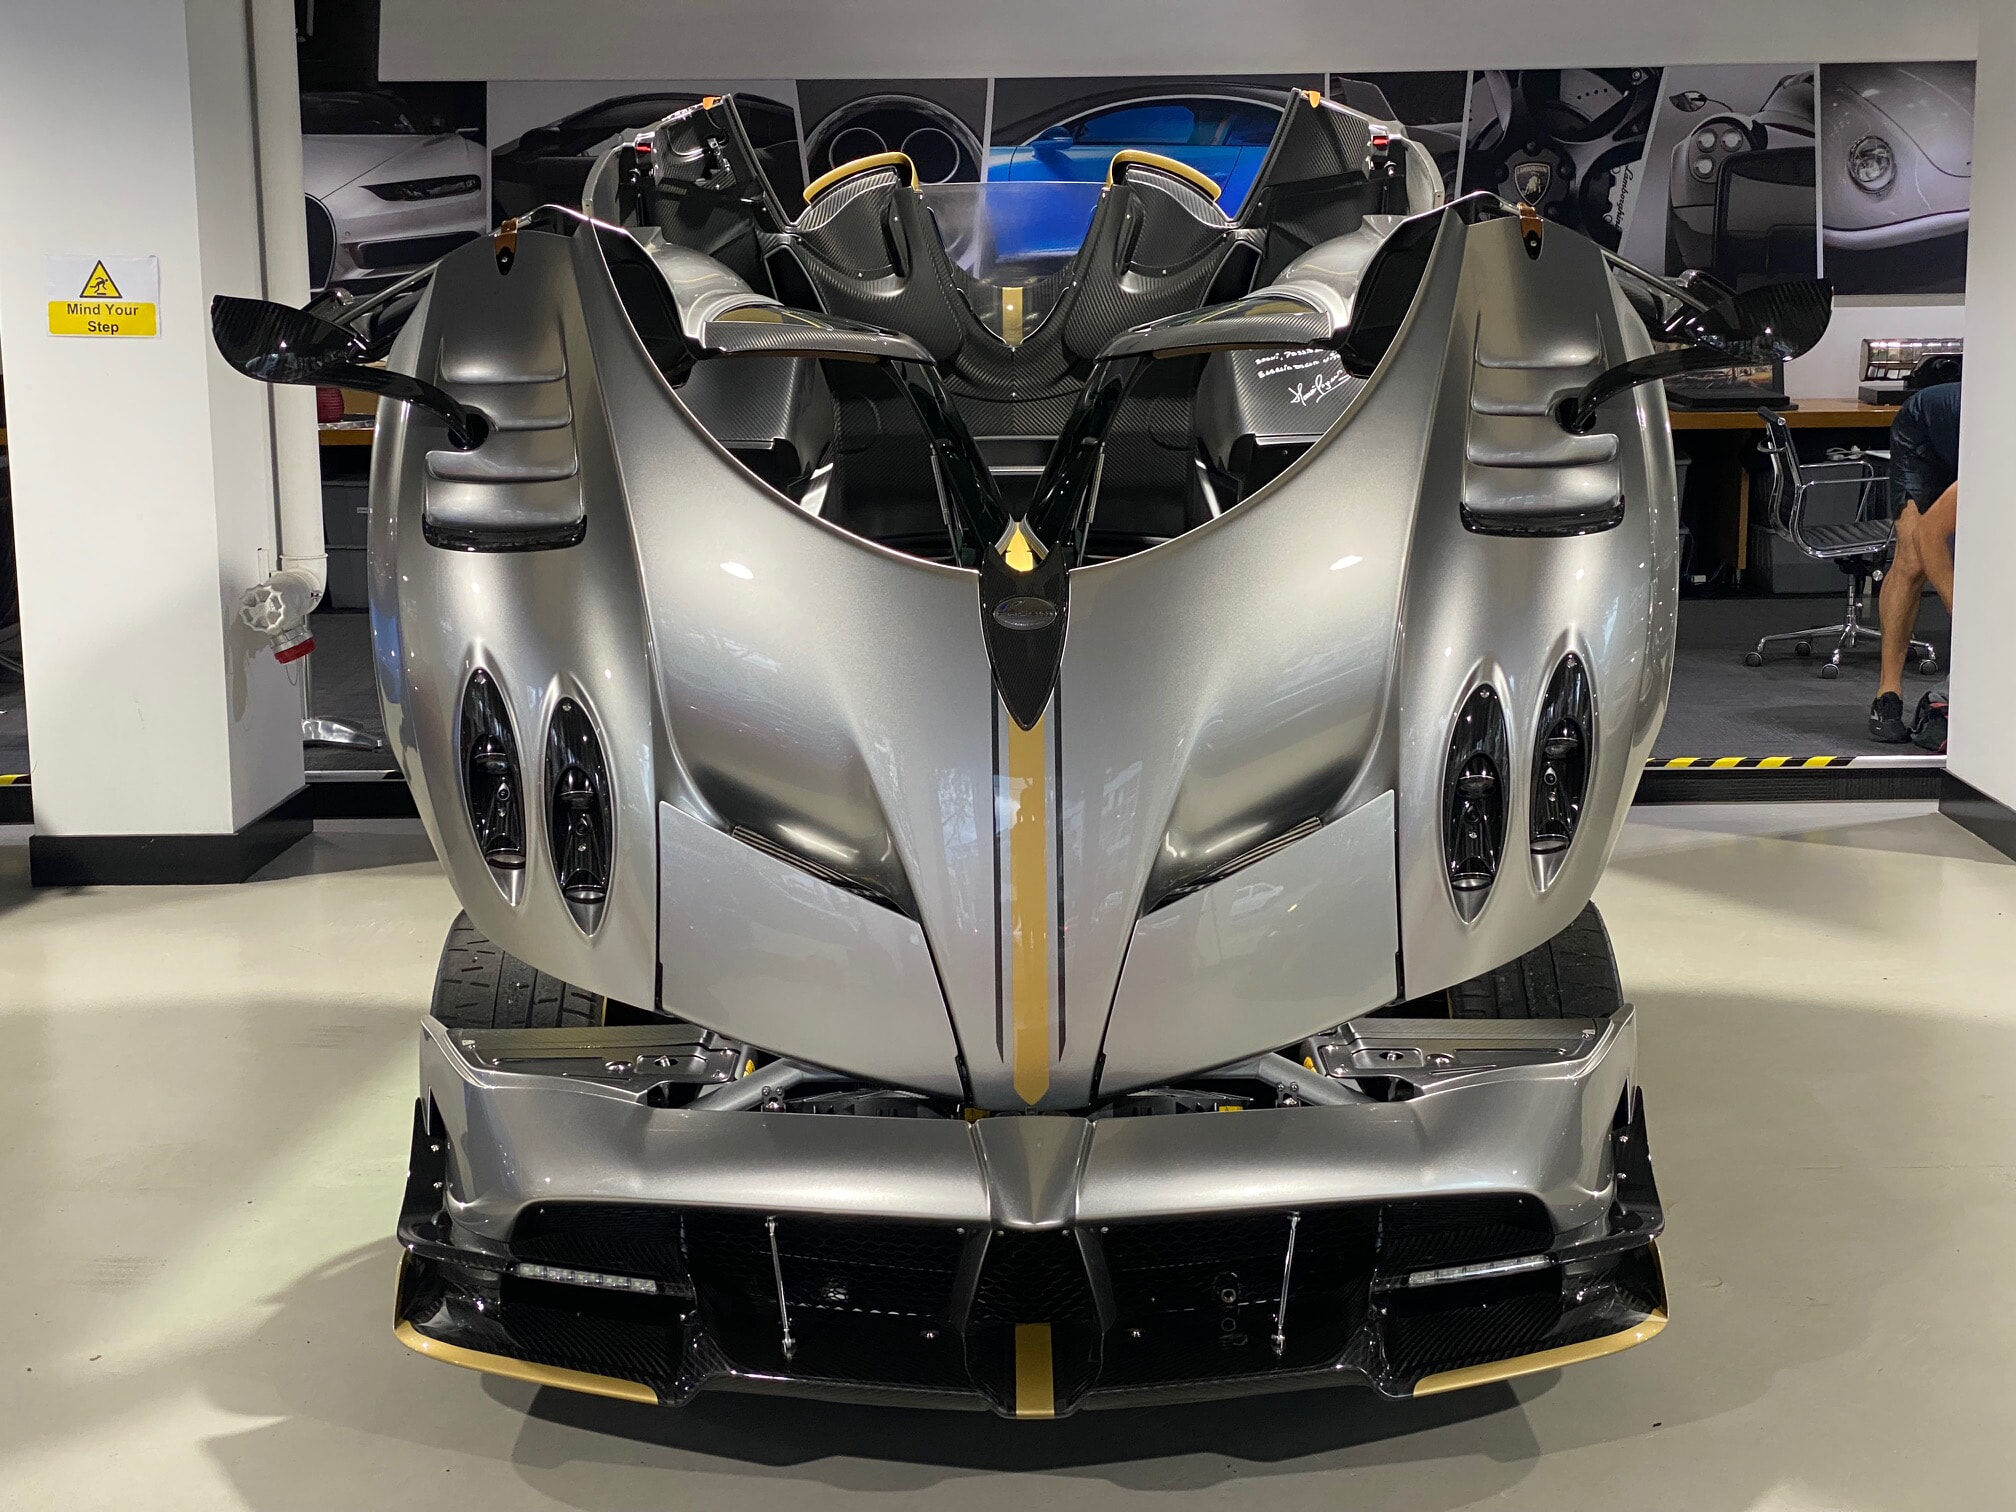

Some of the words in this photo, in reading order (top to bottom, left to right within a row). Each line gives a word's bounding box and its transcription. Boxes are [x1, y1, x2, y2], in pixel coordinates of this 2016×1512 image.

[1615, 164, 1633, 230] Lamborghini
[67, 303, 100, 315] Mind
[105, 304, 138, 316] Your
[87, 320, 119, 335] Step
